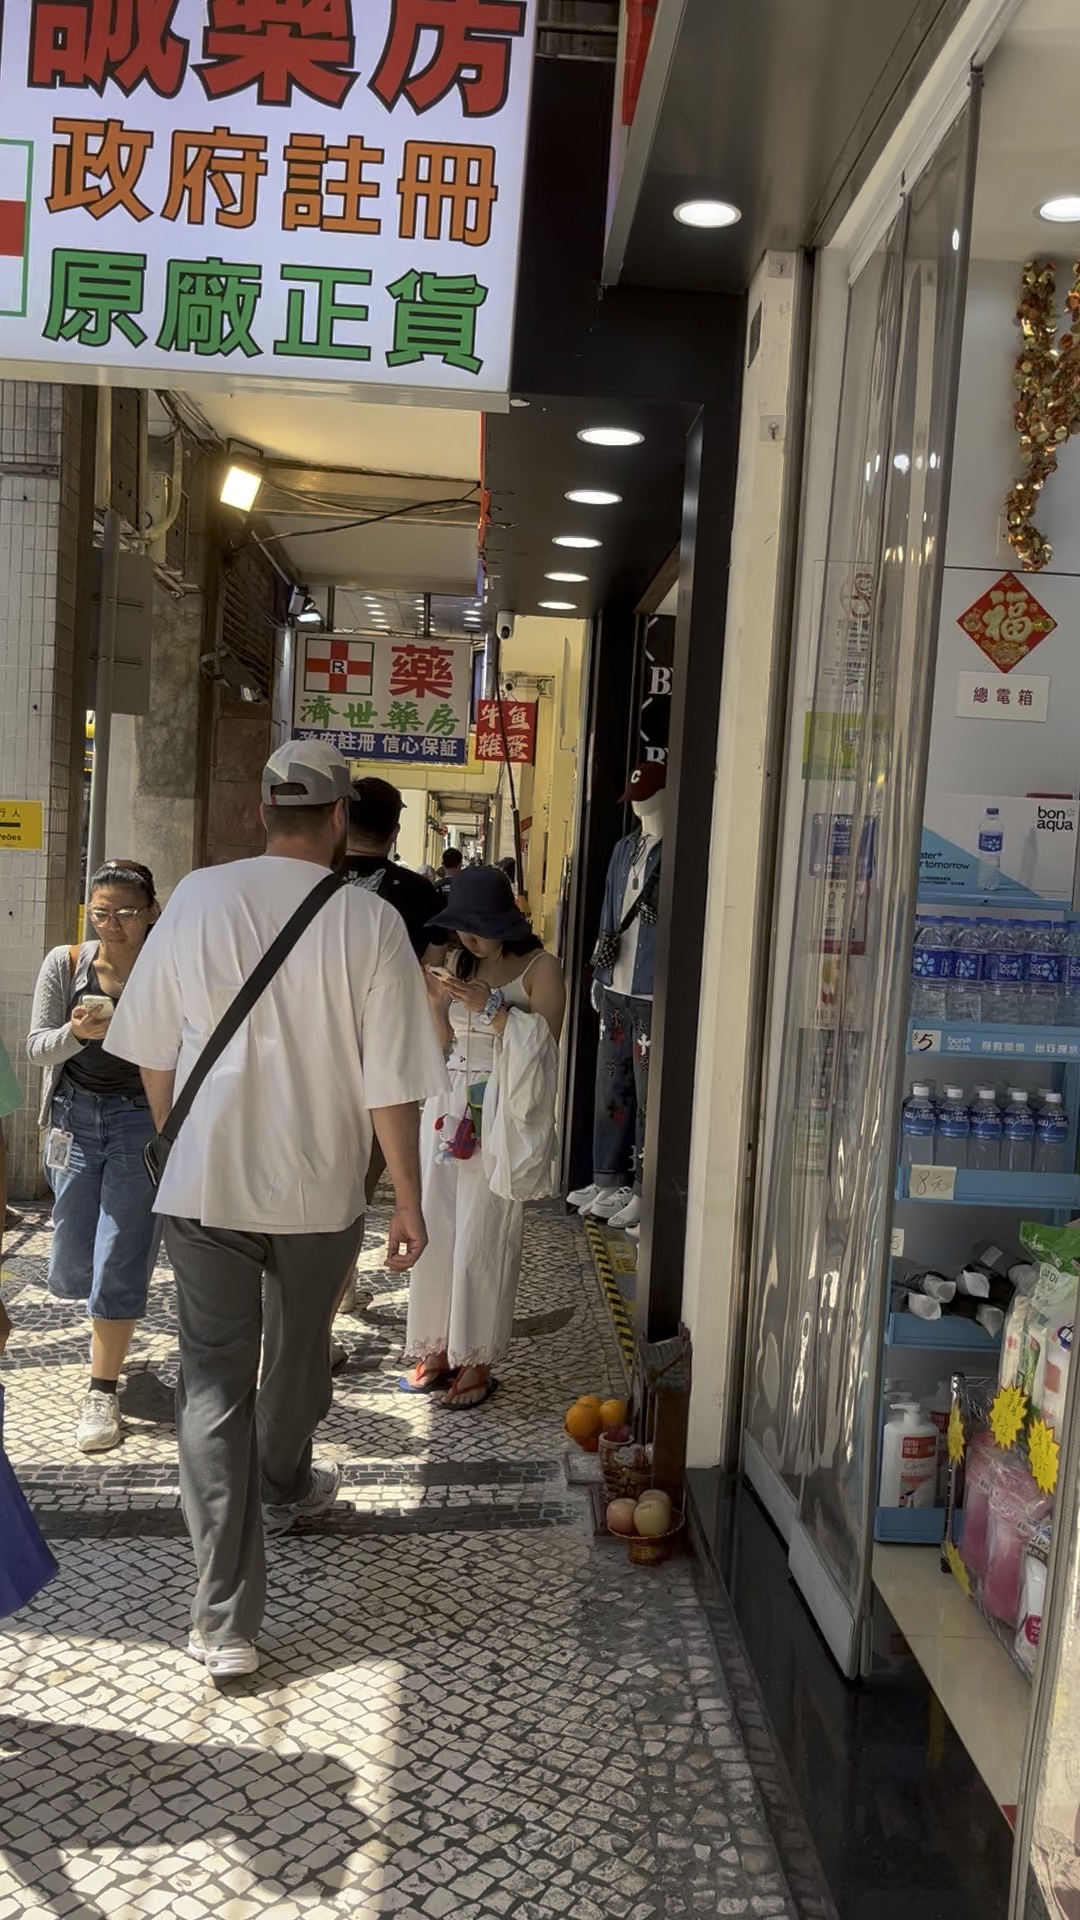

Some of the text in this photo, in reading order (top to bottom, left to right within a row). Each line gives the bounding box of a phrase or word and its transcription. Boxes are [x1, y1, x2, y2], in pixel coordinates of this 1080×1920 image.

[45, 117, 498, 247] 政府註冊
[41, 248, 488, 375] 原廠正貨
[388, 644, 454, 699] 藥
[973, 686, 1034, 707] 總電箱
[300, 695, 460, 737] 濟世藥房
[382, 734, 458, 757] 信心保証
[631, 770, 642, 784] C
[1037, 806, 1066, 820] bon
[1037, 820, 1074, 832] aqua
[925, 861, 970, 870] tomorrow
[914, 1032, 934, 1051] $5
